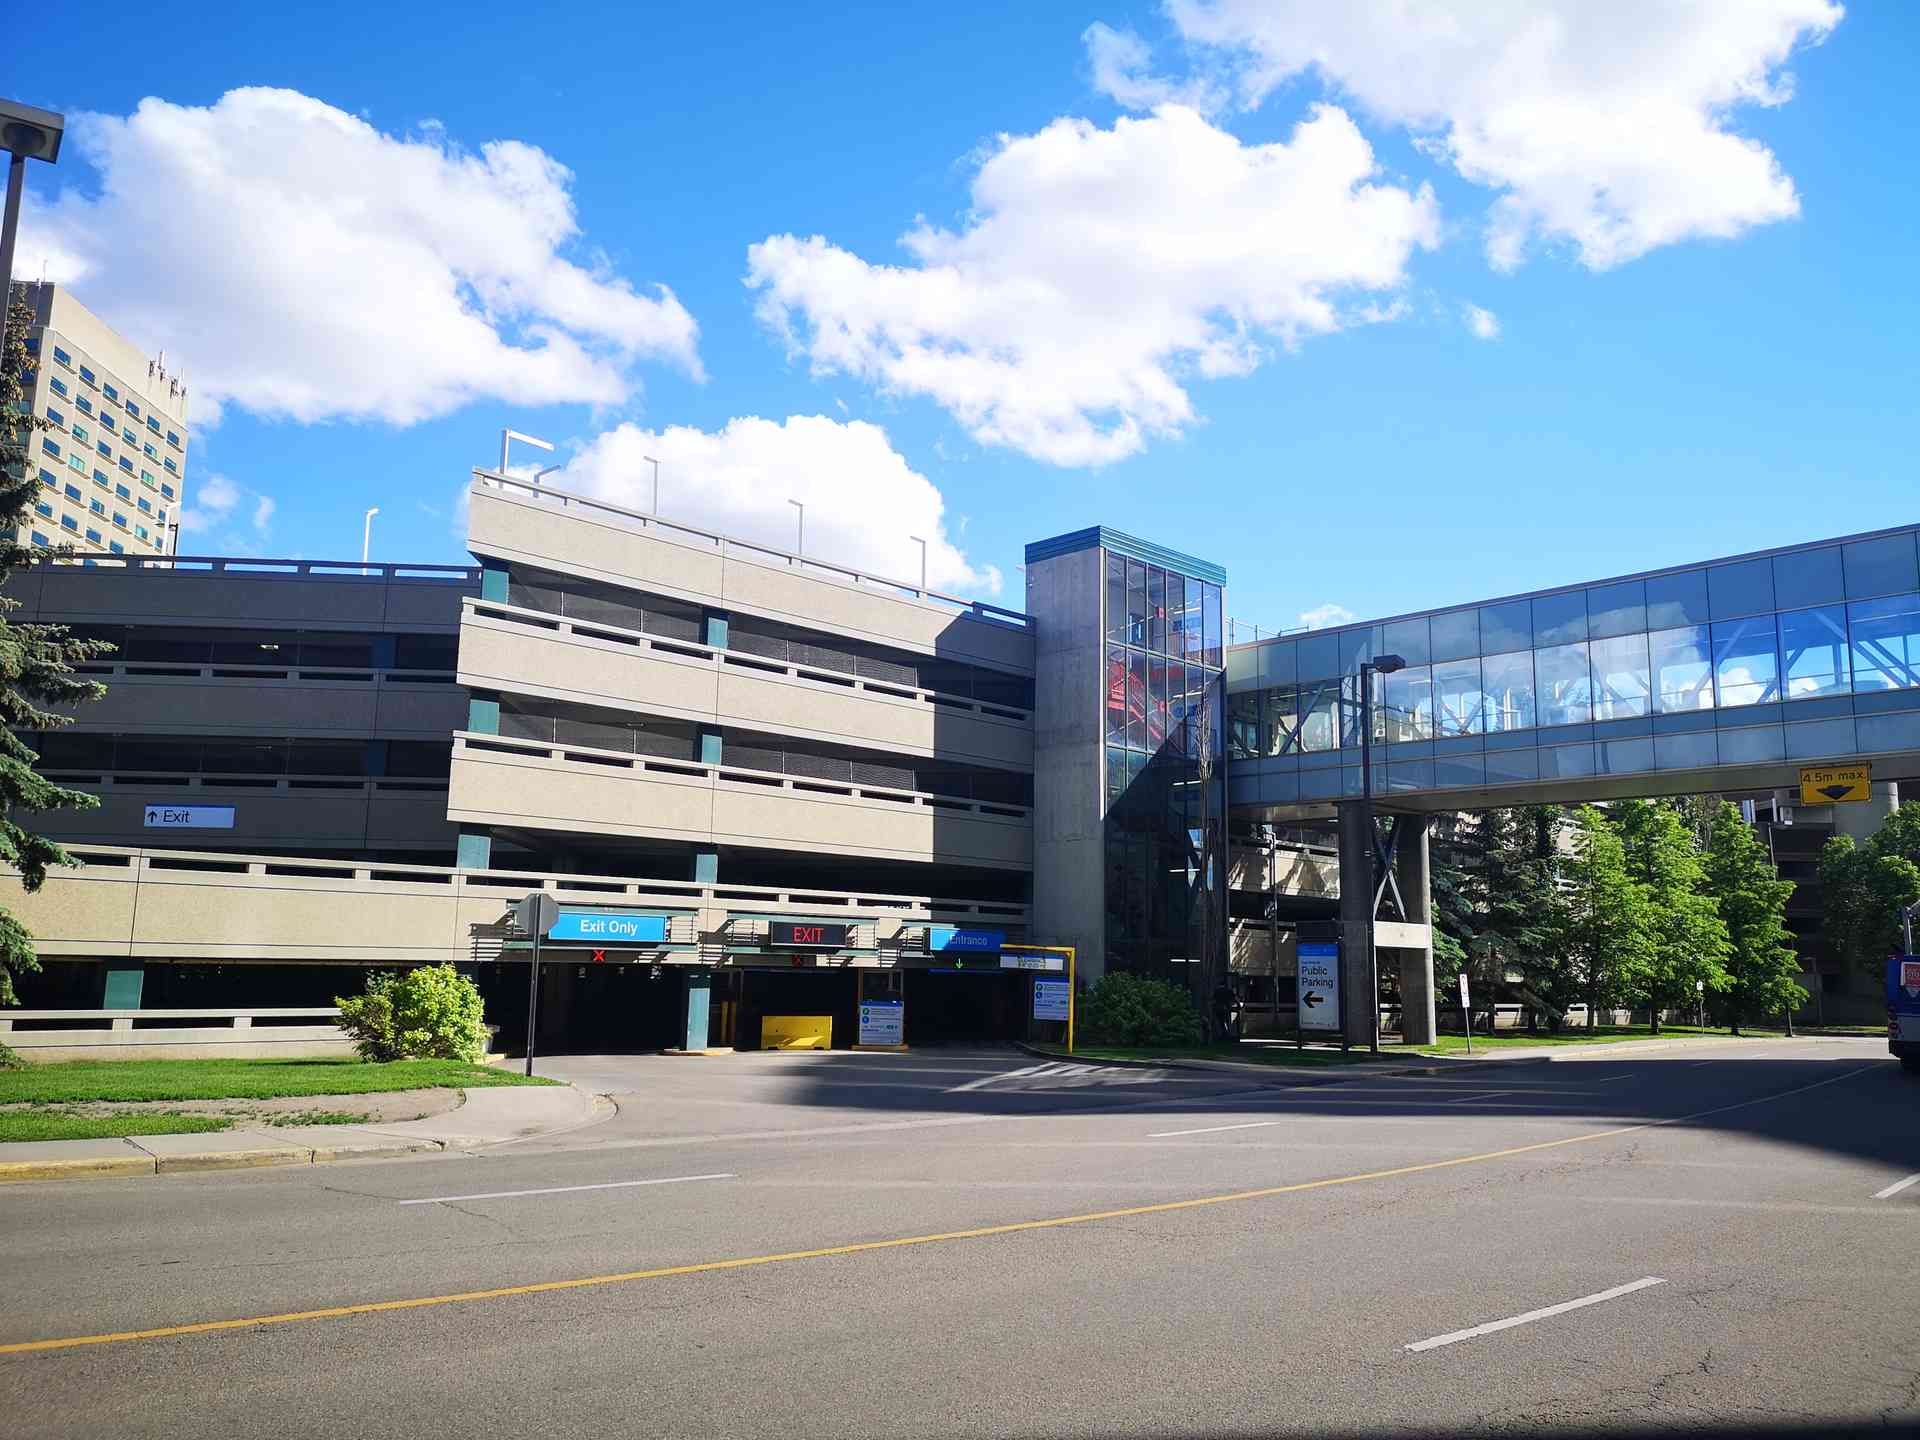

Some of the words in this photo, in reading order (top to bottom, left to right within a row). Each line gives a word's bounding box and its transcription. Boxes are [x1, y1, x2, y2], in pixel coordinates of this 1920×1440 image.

[163, 809, 190, 823] Exit
[580, 919, 605, 933] Exit
[608, 920, 638, 937] Only
[793, 926, 825, 943] EXIT
[1302, 965, 1328, 976] Public
[1302, 977, 1334, 989] Parking
